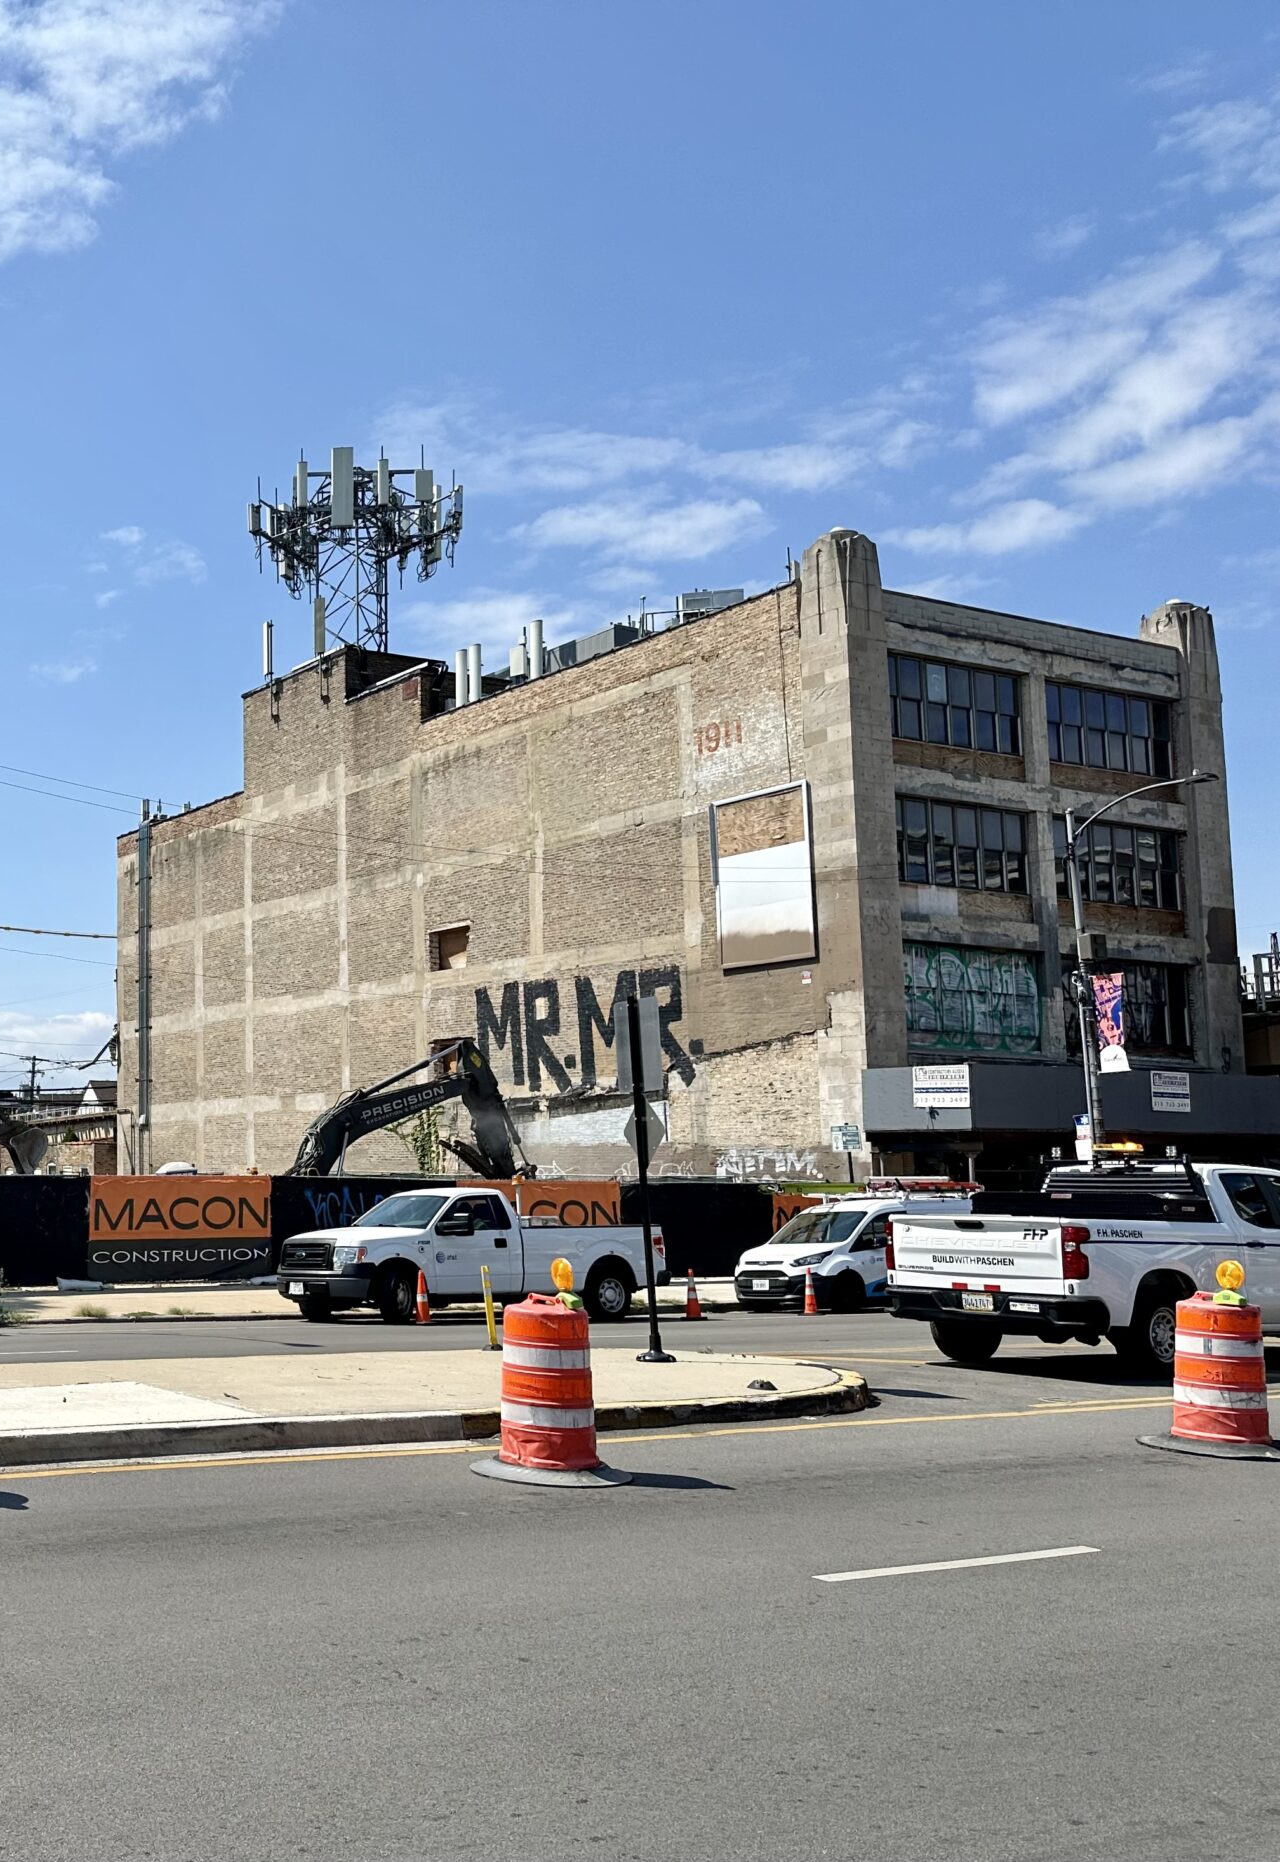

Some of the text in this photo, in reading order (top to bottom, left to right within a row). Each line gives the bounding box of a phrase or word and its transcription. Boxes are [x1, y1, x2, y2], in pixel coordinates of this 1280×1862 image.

[361, 1086, 445, 1119] PRECISION
[94, 1196, 269, 1231] MACON
[528, 1199, 619, 1226] CON
[901, 1235, 1047, 1250] CHEVROLET
[1023, 1228, 1048, 1240] FHP
[1097, 1229, 1143, 1239] F.H. PASCHEN
[92, 1247, 269, 1264] CONSTRUCTION
